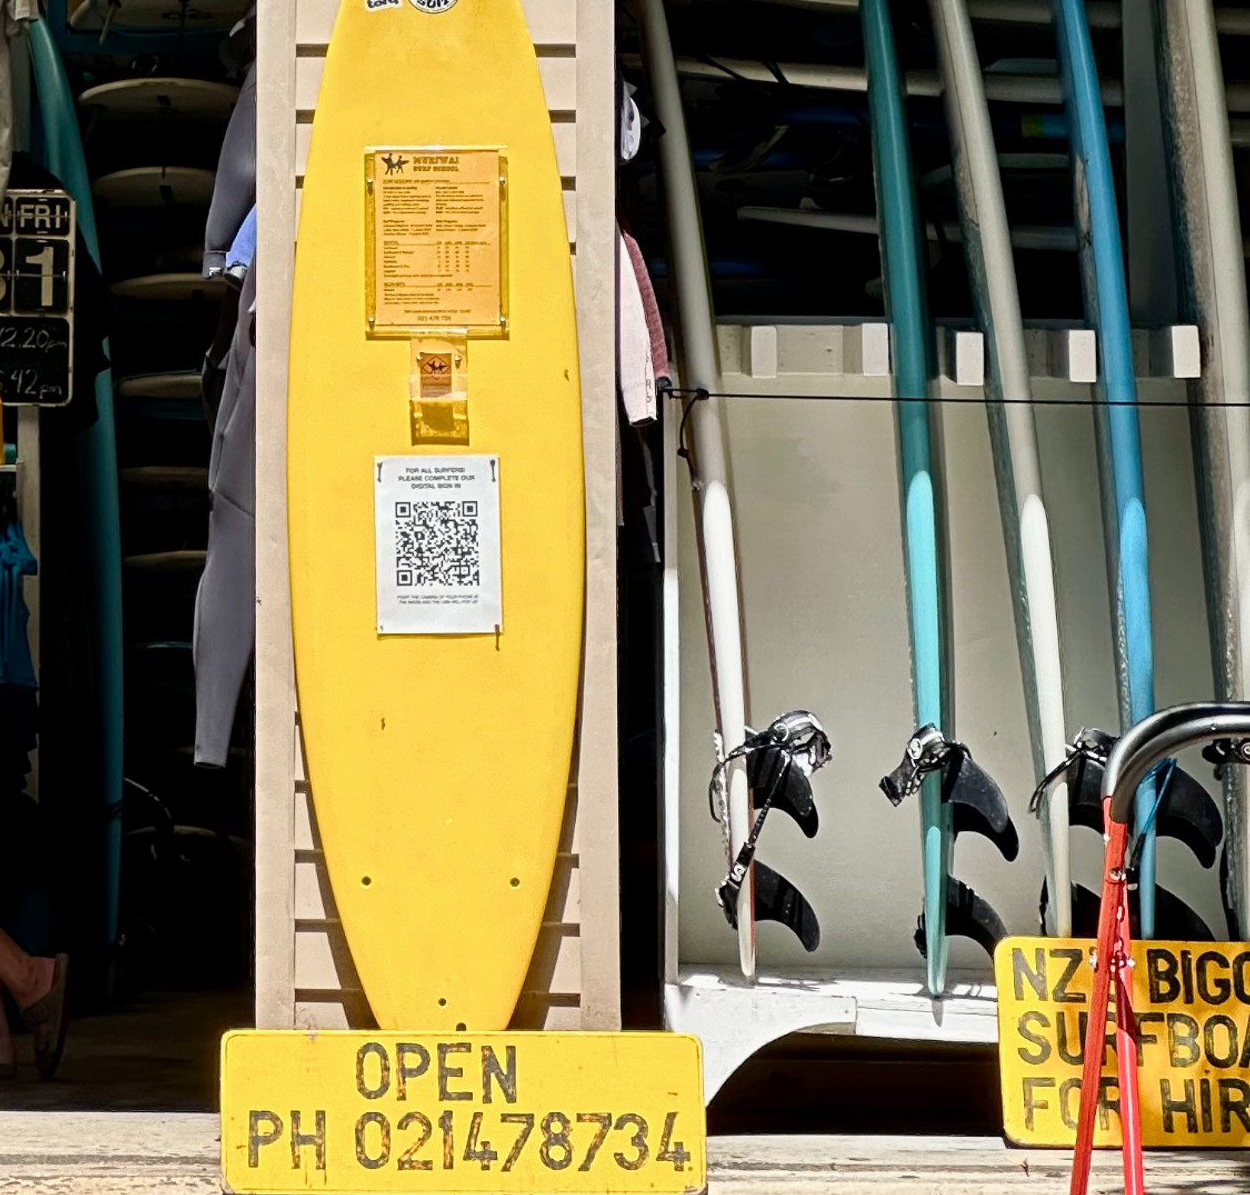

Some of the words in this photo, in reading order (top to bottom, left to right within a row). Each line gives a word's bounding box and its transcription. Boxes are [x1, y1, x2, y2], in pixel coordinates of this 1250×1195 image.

[19, 204, 61, 229] FRI
[1011, 947, 1117, 1003] NZ'
[355, 1041, 517, 1103] OPEN
[248, 1109, 327, 1170] PH
[354, 1110, 692, 1172] 021478734
